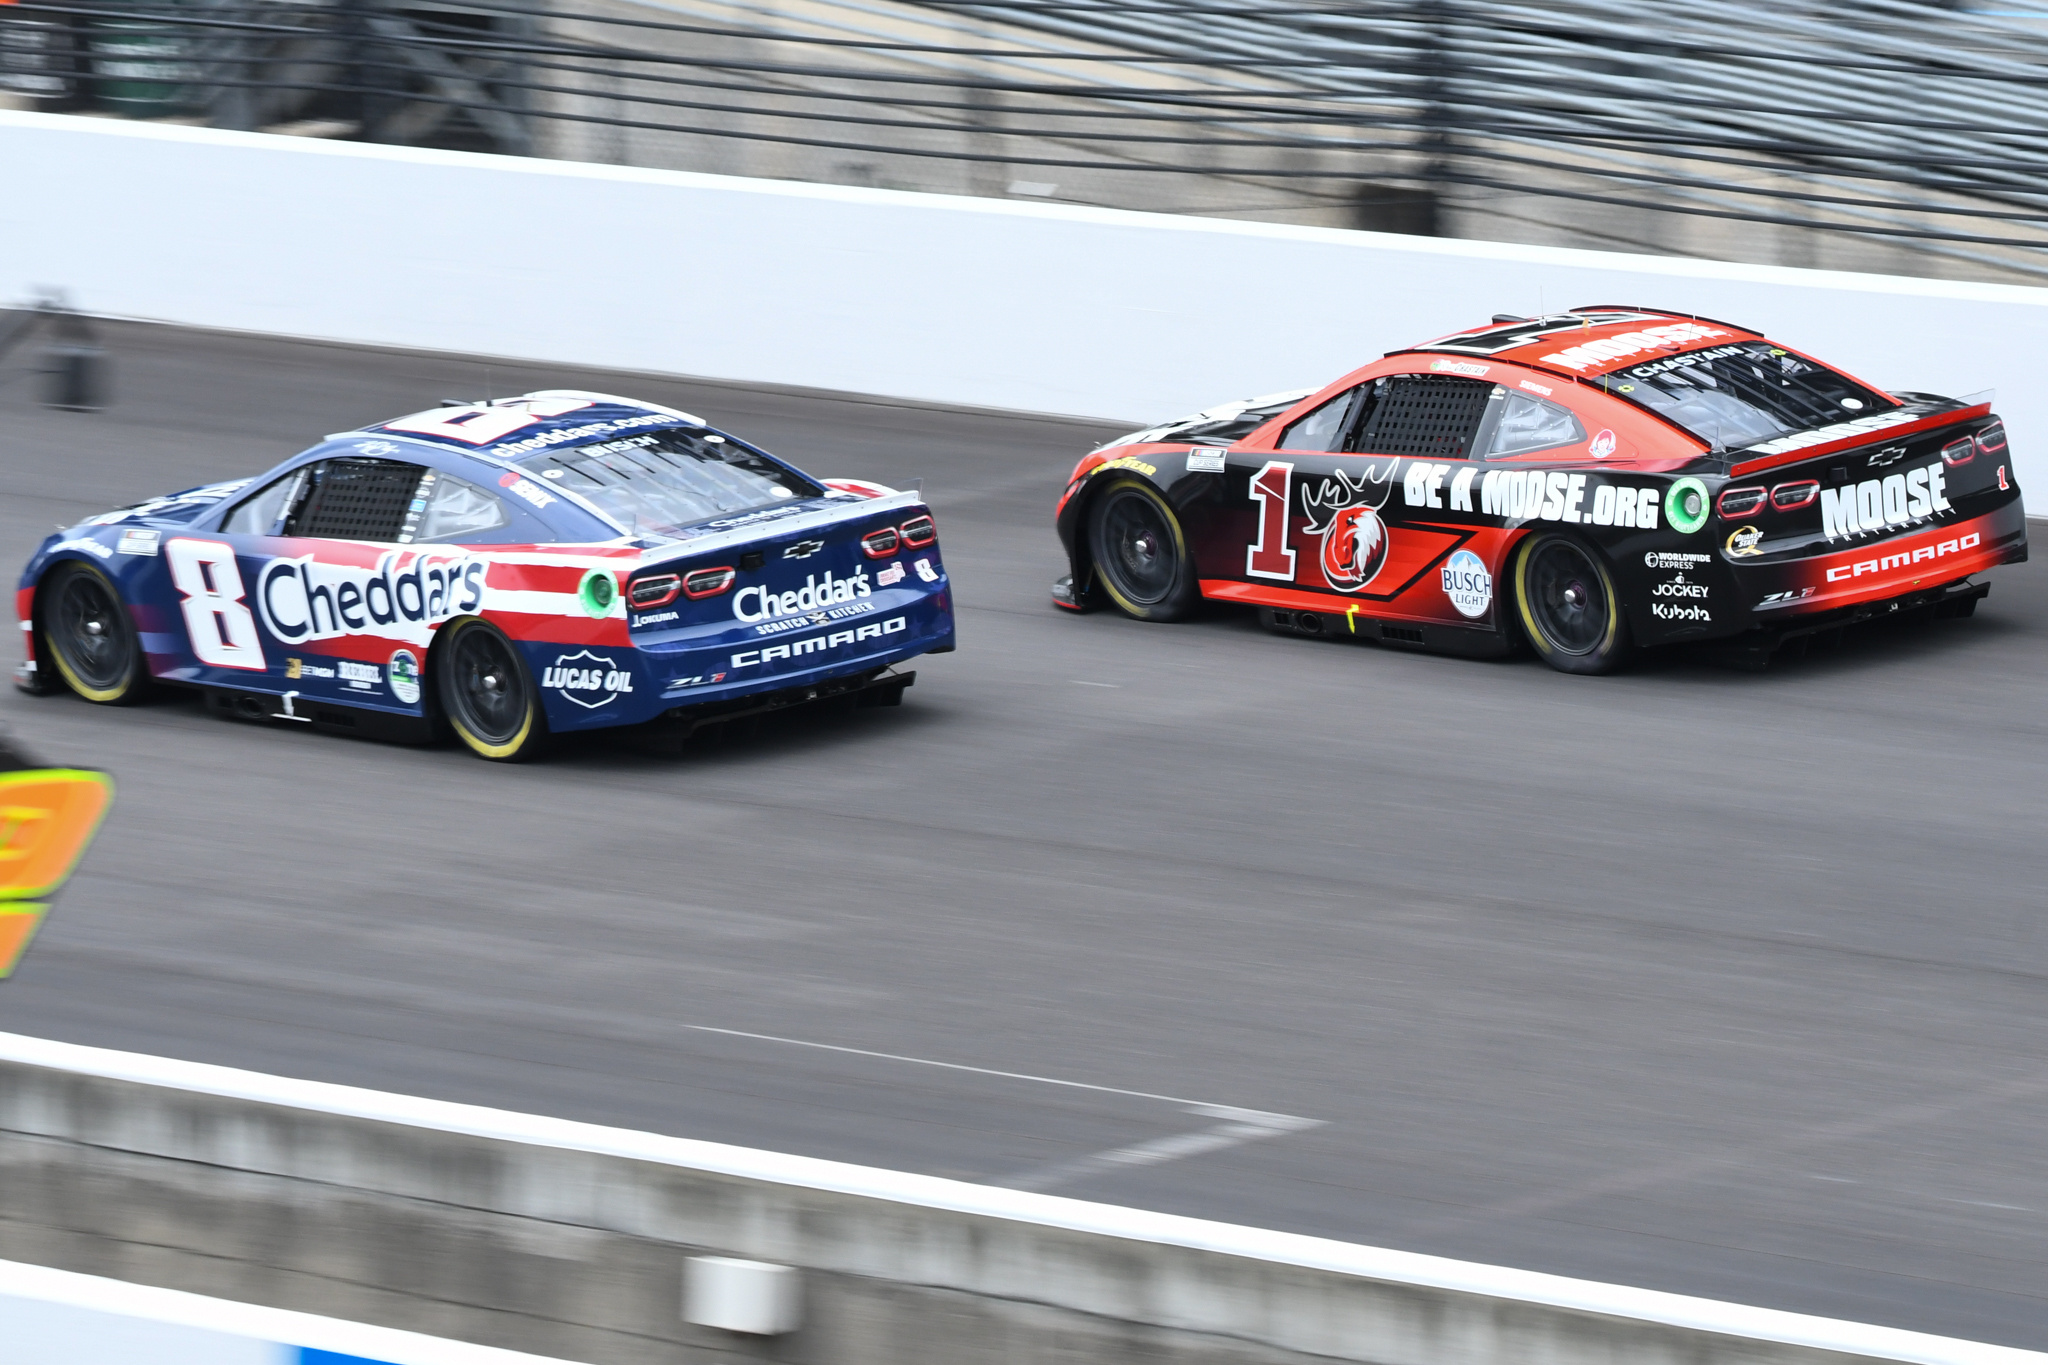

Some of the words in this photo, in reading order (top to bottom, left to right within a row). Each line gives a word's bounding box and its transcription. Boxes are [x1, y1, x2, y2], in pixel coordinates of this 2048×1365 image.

[1539, 322, 1727, 370] MOOSE
[1631, 346, 1745, 378] CHASTAIN
[1519, 380, 1553, 397] SIEMENS
[490, 413, 680, 458] cheddars.com
[1997, 465, 2010, 491] 1
[1403, 461, 1452, 509] BE
[1450, 466, 1479, 512] A
[1481, 469, 1660, 530] MOOSE.ORG
[1820, 461, 1952, 539] MOOSE
[1246, 460, 1297, 582] 1
[1828, 507, 1957, 545] FRATERNITY
[913, 558, 939, 582] 8
[1658, 552, 1711, 563] WORLDWIDE
[1659, 561, 1694, 570] EXPRESS
[1826, 532, 1980, 583] CAMARO
[732, 564, 872, 623] Cheddar's
[1443, 569, 1492, 597] BUSCH
[1652, 584, 1709, 598] JOCKEY
[165, 537, 268, 672] 8
[1456, 593, 1485, 606] LIGHT
[1652, 603, 1711, 621] Kubota
[755, 616, 810, 635] SCRATCH
[828, 602, 876, 620] KITCHEN
[730, 616, 907, 669] CAMARO
[541, 667, 603, 691] LUCAS
[604, 670, 634, 693] OIL
